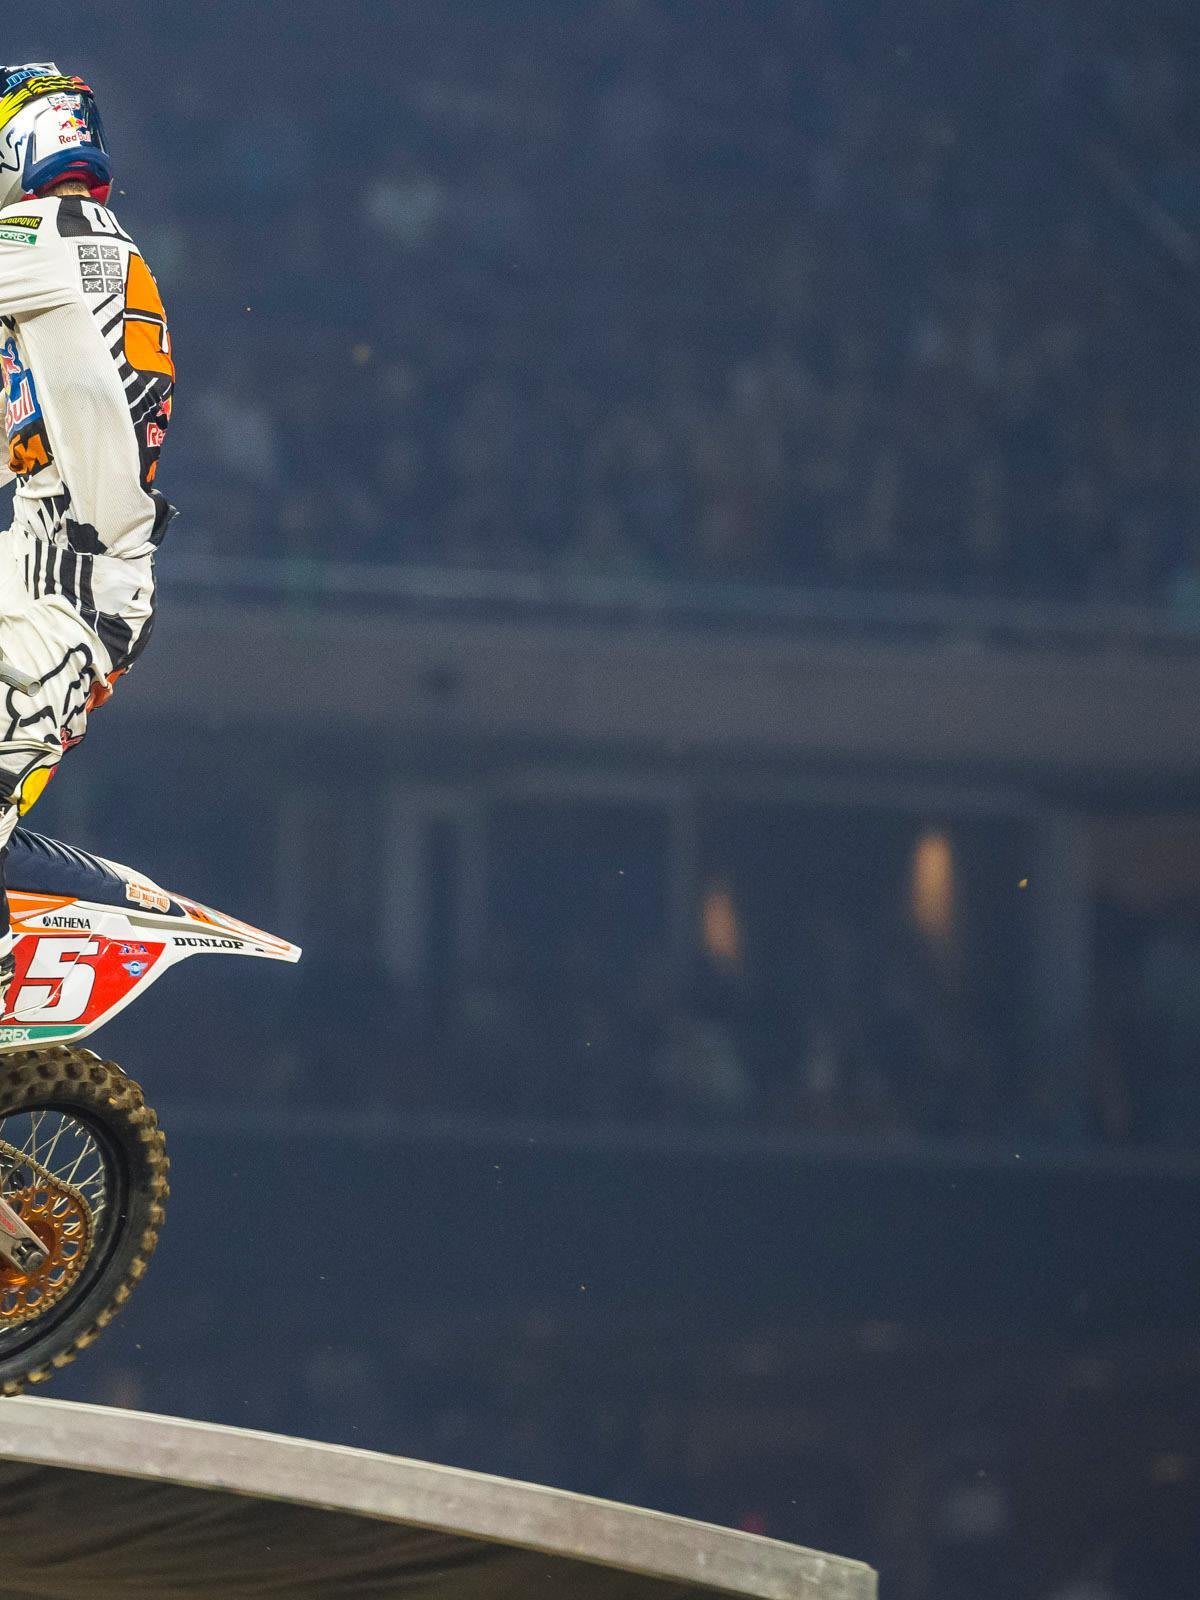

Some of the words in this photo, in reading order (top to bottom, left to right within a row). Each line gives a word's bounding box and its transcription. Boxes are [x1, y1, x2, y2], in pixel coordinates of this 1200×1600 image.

[58, 134, 77, 145] Red
[77, 131, 91, 143] Bull
[51, 916, 91, 929] ATHENA
[173, 937, 244, 950] DUNLOP
[13, 936, 100, 1022] 5
